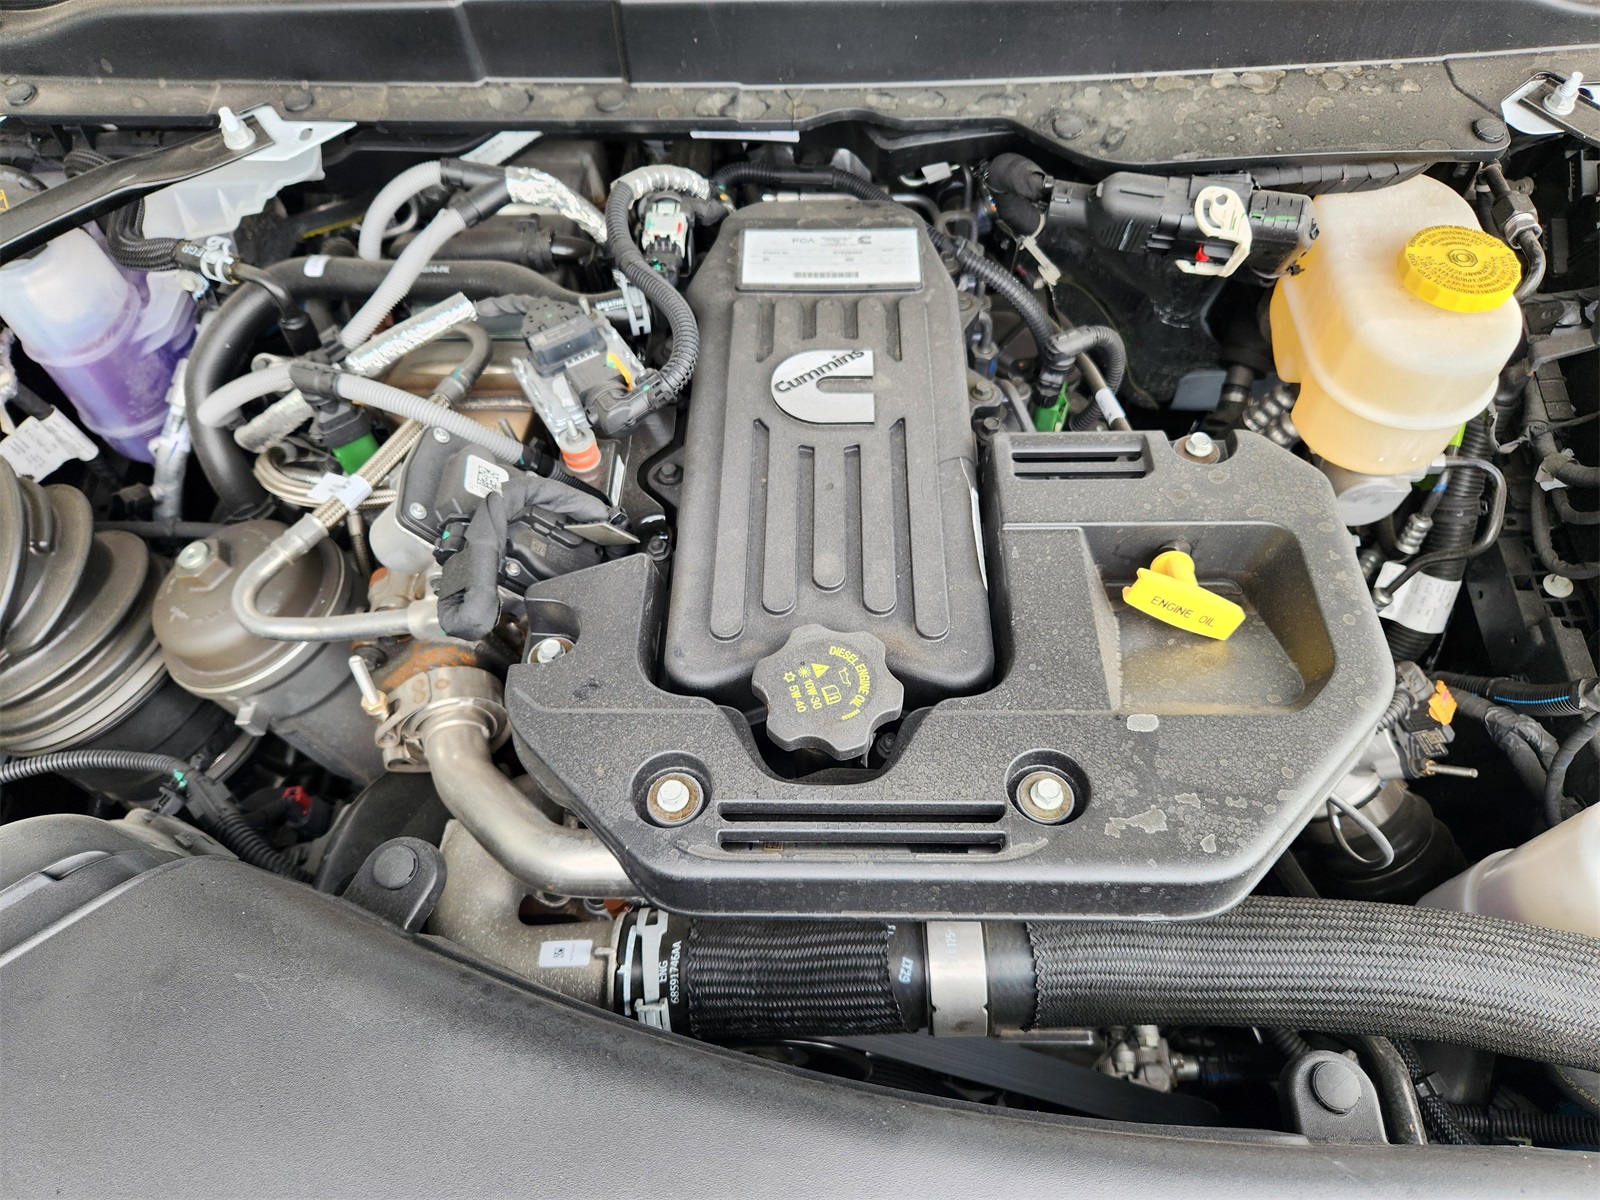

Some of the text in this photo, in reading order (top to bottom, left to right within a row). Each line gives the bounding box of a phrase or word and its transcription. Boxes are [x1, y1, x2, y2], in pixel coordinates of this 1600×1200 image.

[774, 350, 865, 393] Cummins
[1150, 596, 1215, 628] ENGINE OIL
[829, 646, 859, 666] DIESEL
[804, 678, 823, 710] 10W-30
[854, 662, 871, 696] ENGINE
[788, 685, 807, 713] 5W-40
[850, 694, 866, 708] OIL
[658, 959, 668, 984] ENG
[669, 940, 682, 1004] 68591746AA
